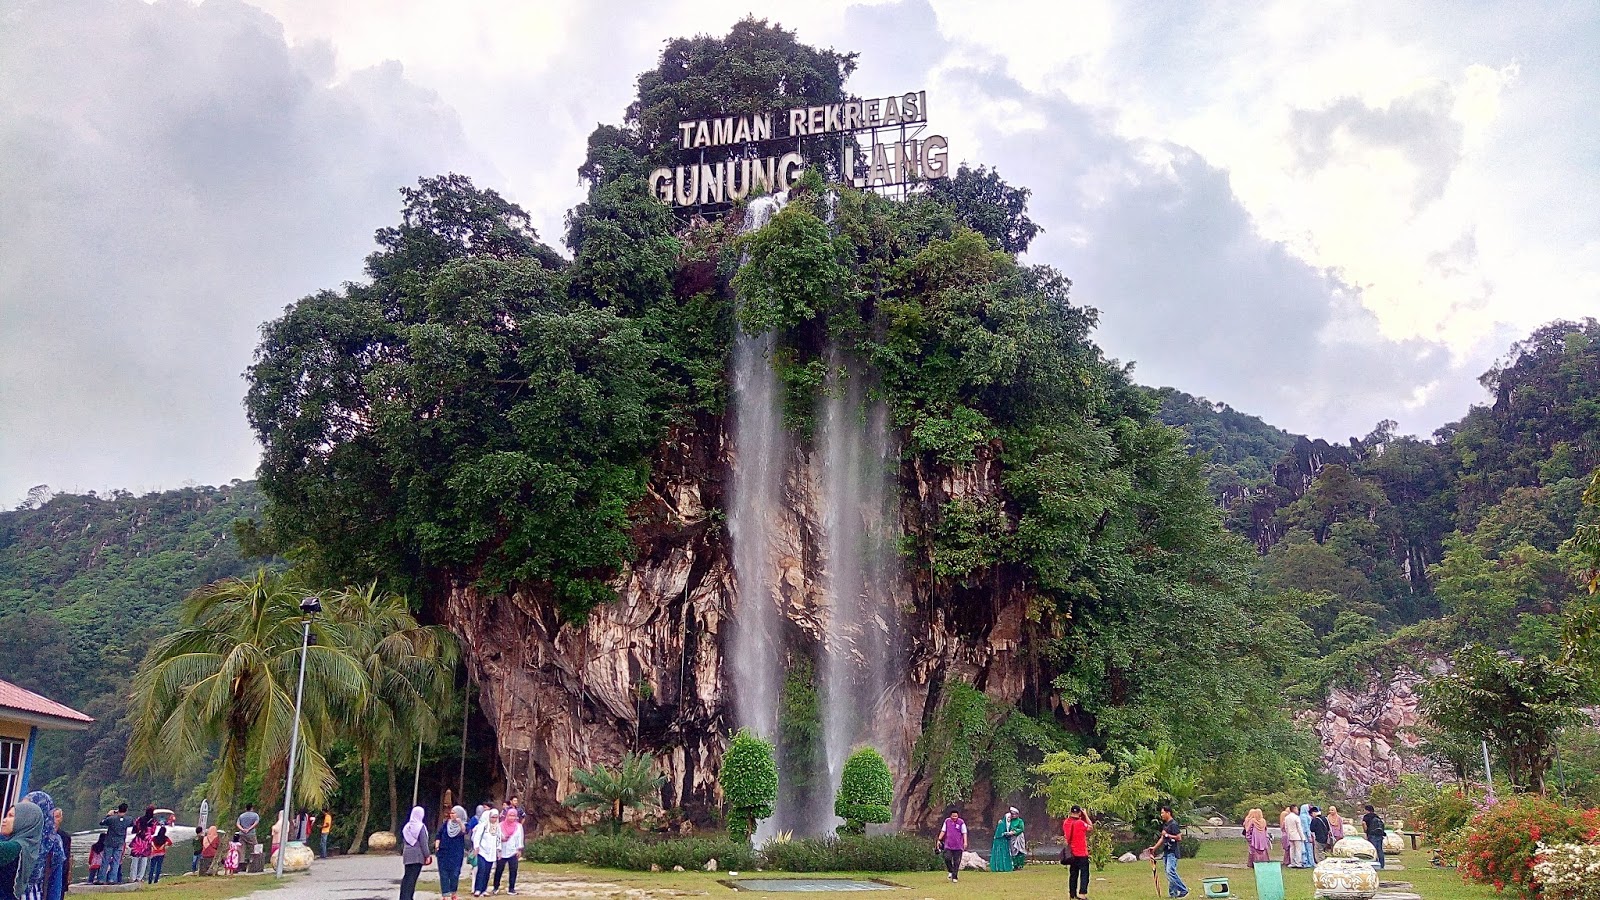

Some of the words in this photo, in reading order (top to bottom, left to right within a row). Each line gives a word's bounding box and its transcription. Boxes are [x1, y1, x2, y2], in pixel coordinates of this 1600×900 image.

[679, 112, 771, 148] TAMAN
[789, 90, 926, 136] REKREASI
[648, 151, 804, 206] GUNUNG
[844, 135, 948, 188] LANG
